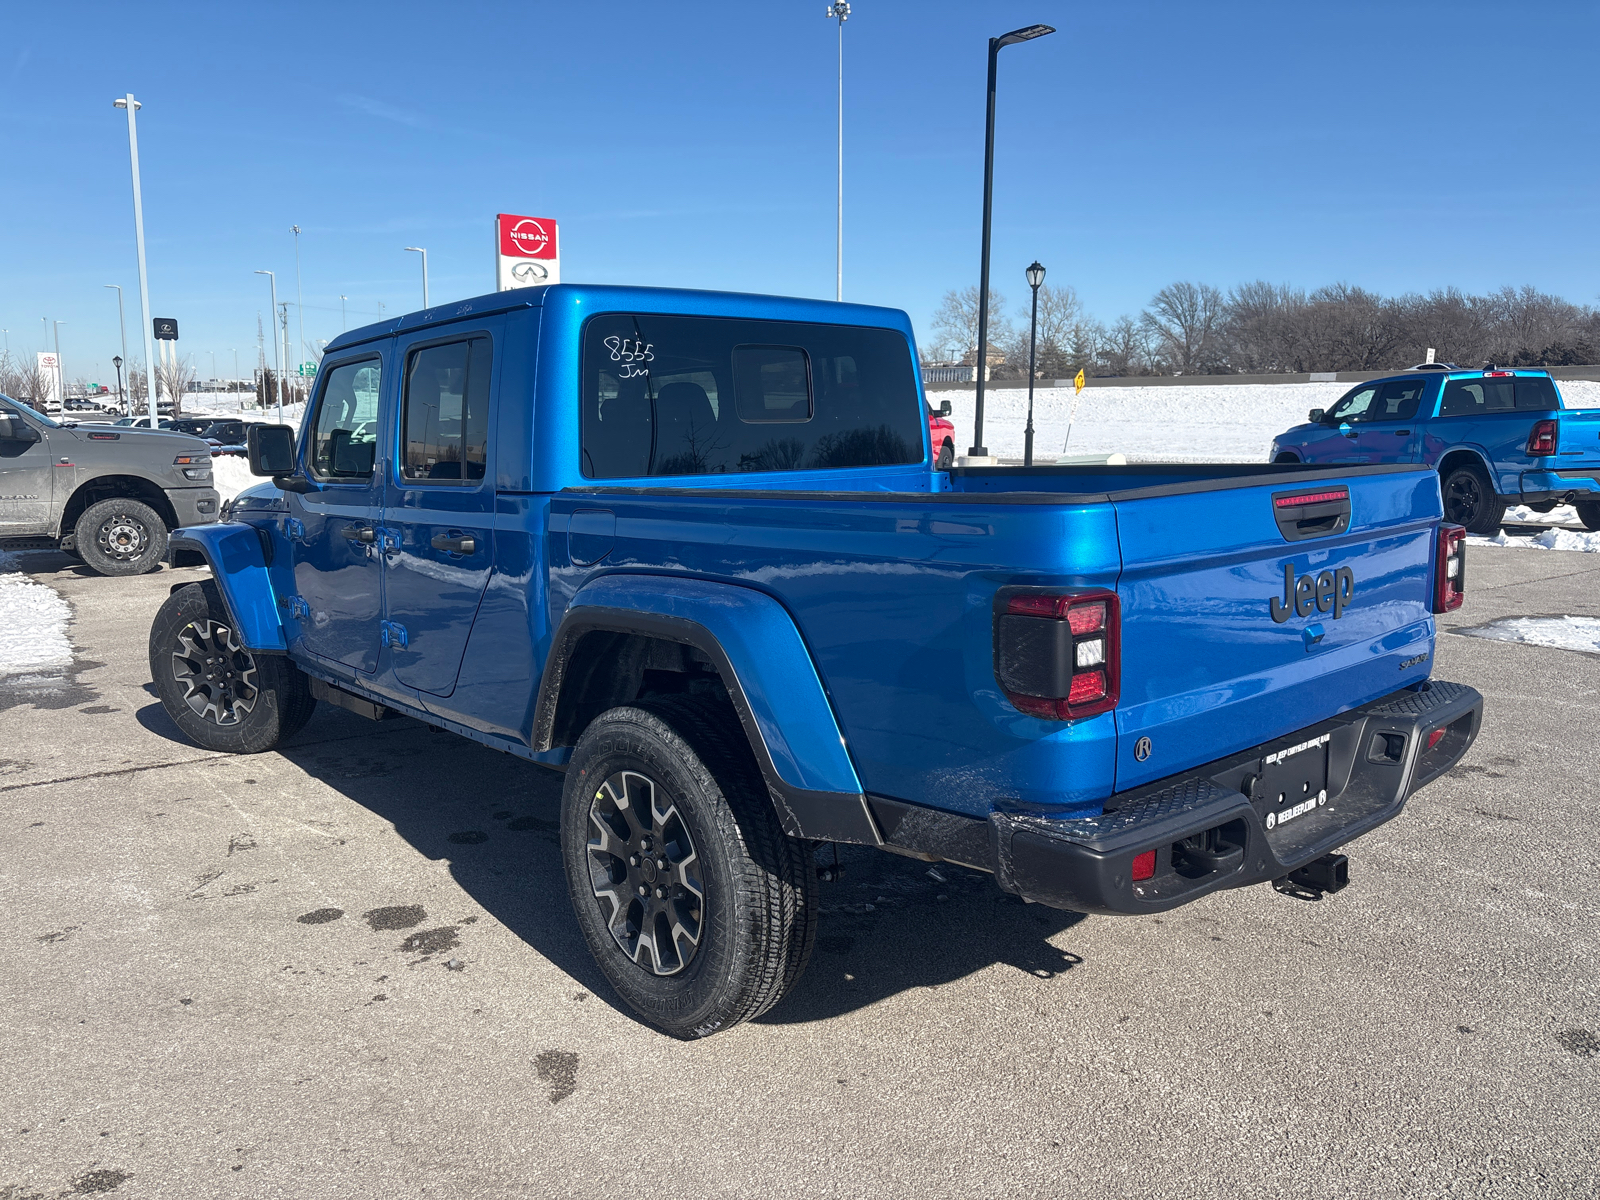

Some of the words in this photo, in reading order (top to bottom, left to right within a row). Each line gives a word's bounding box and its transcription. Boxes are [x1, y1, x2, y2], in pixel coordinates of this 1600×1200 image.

[510, 231, 549, 242] NISSAN
[603, 335, 655, 362] 8555
[1269, 563, 1354, 624] Jeep
[1399, 652, 1430, 671] SAHARA
[1276, 749, 1288, 762] JEEP
[1287, 741, 1308, 757] CHRYSLER
